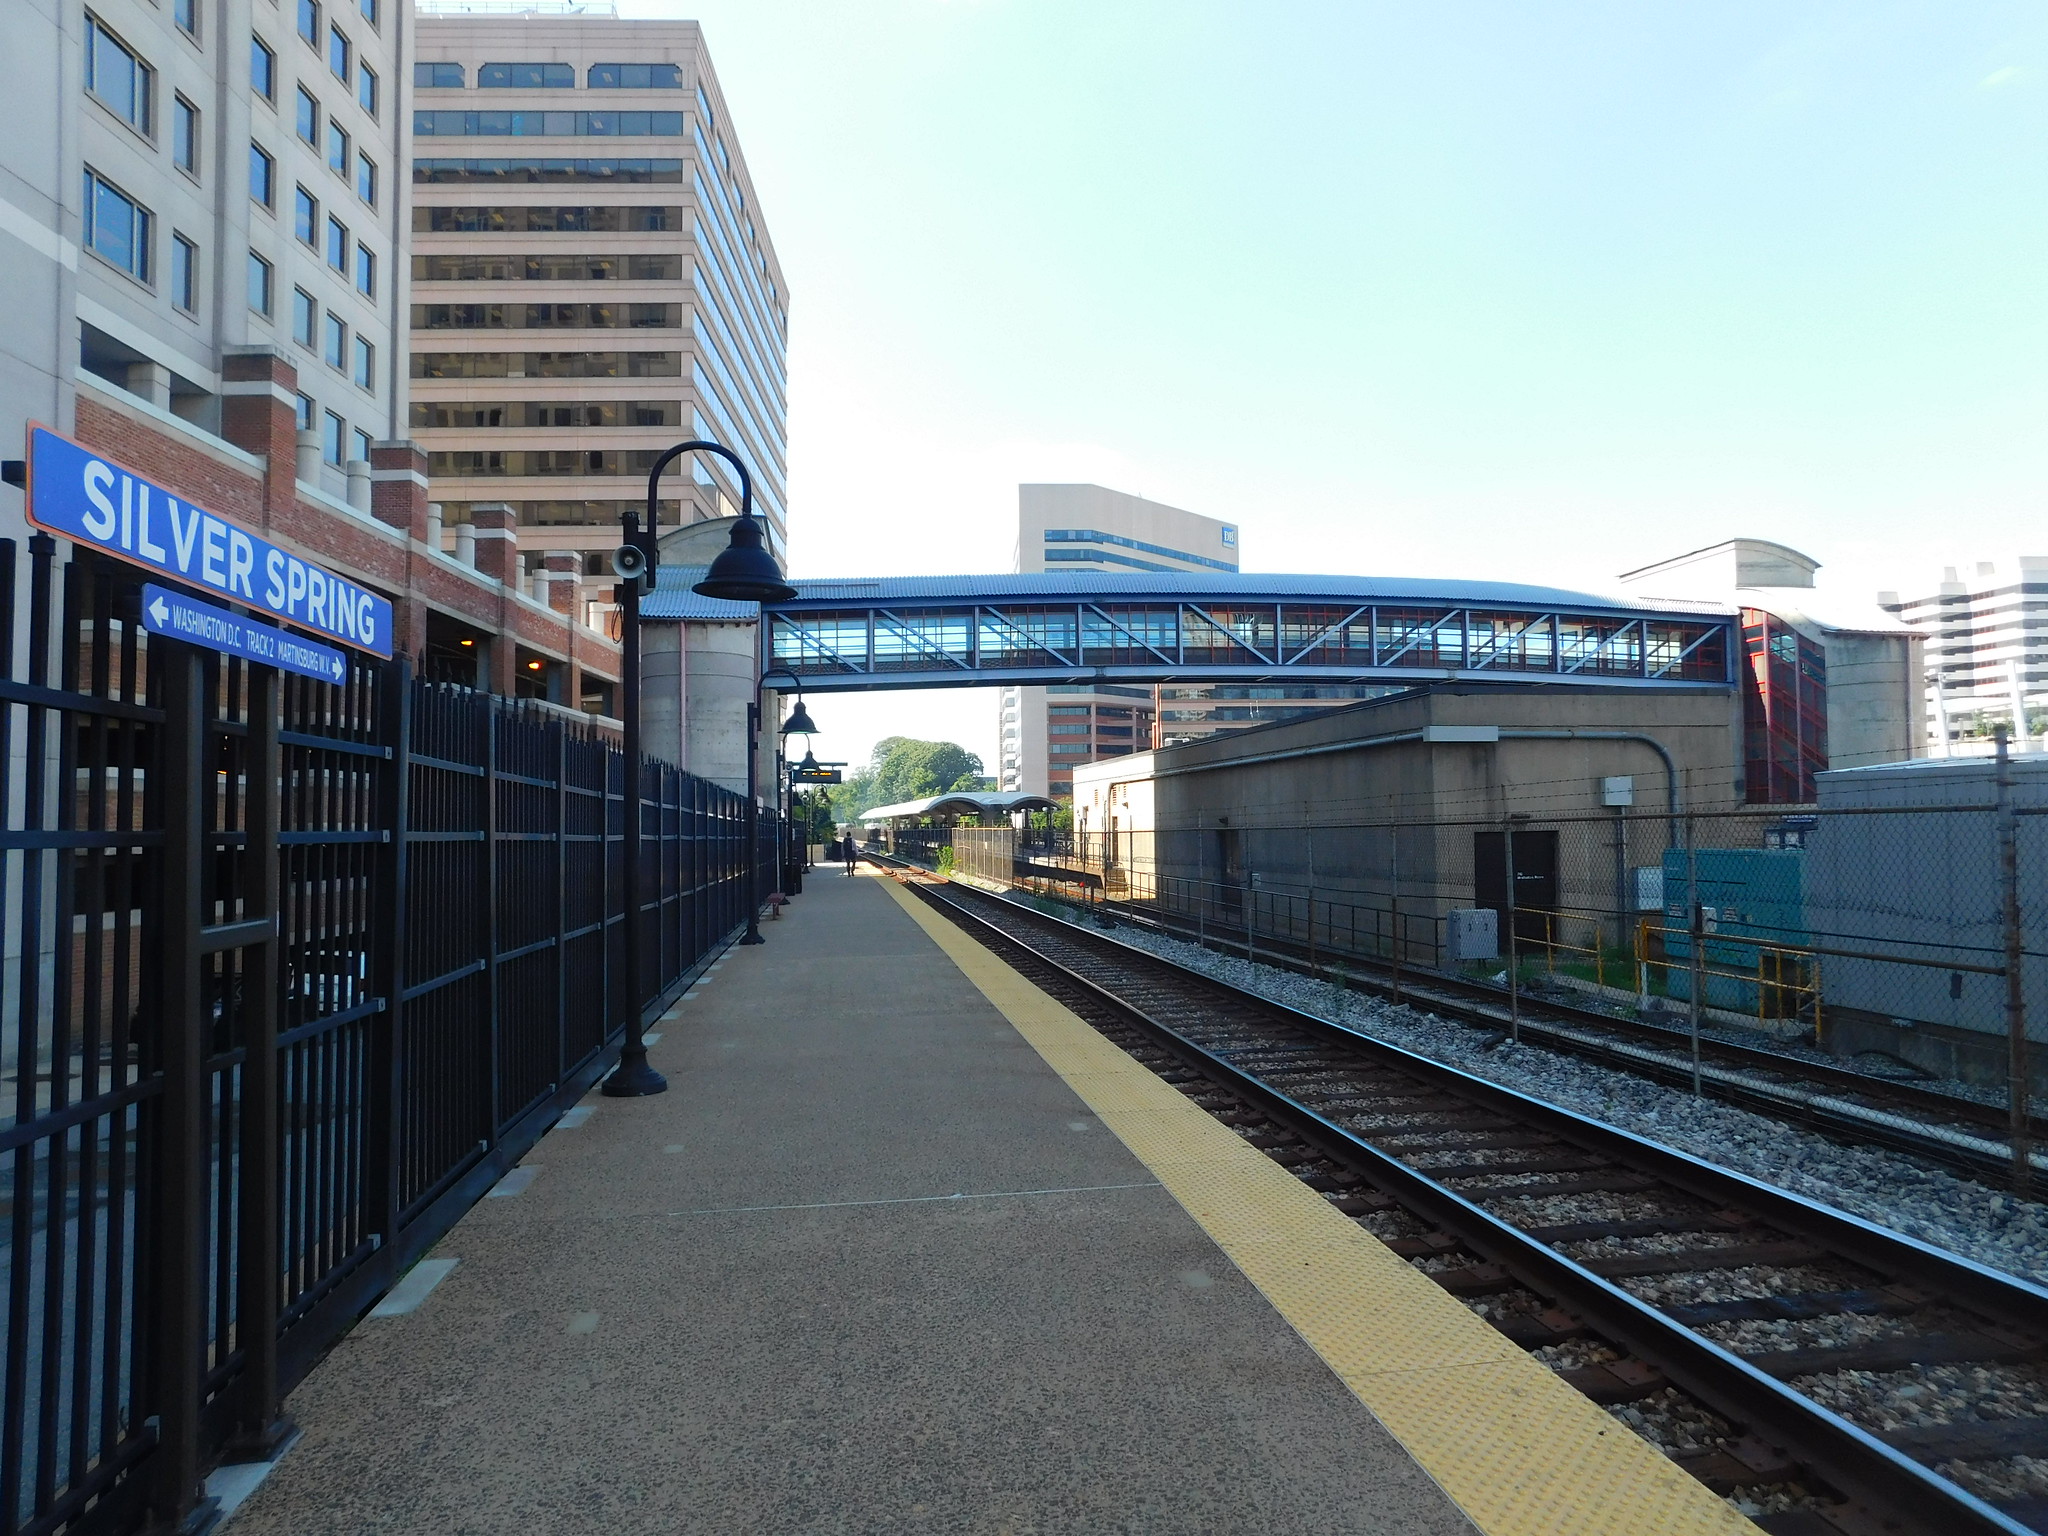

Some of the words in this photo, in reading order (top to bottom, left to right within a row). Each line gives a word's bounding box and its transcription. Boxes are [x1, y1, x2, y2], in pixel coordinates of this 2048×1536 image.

[81, 460, 254, 599] SILVER
[265, 548, 375, 645] SPRING
[172, 604, 227, 643] WASHINGTON
[227, 623, 242, 648] D.C.
[246, 629, 269, 656] TRACK
[269, 637, 274, 658] 2
[278, 641, 319, 671] MARTINSBURG
[319, 653, 331, 675] W.V.
